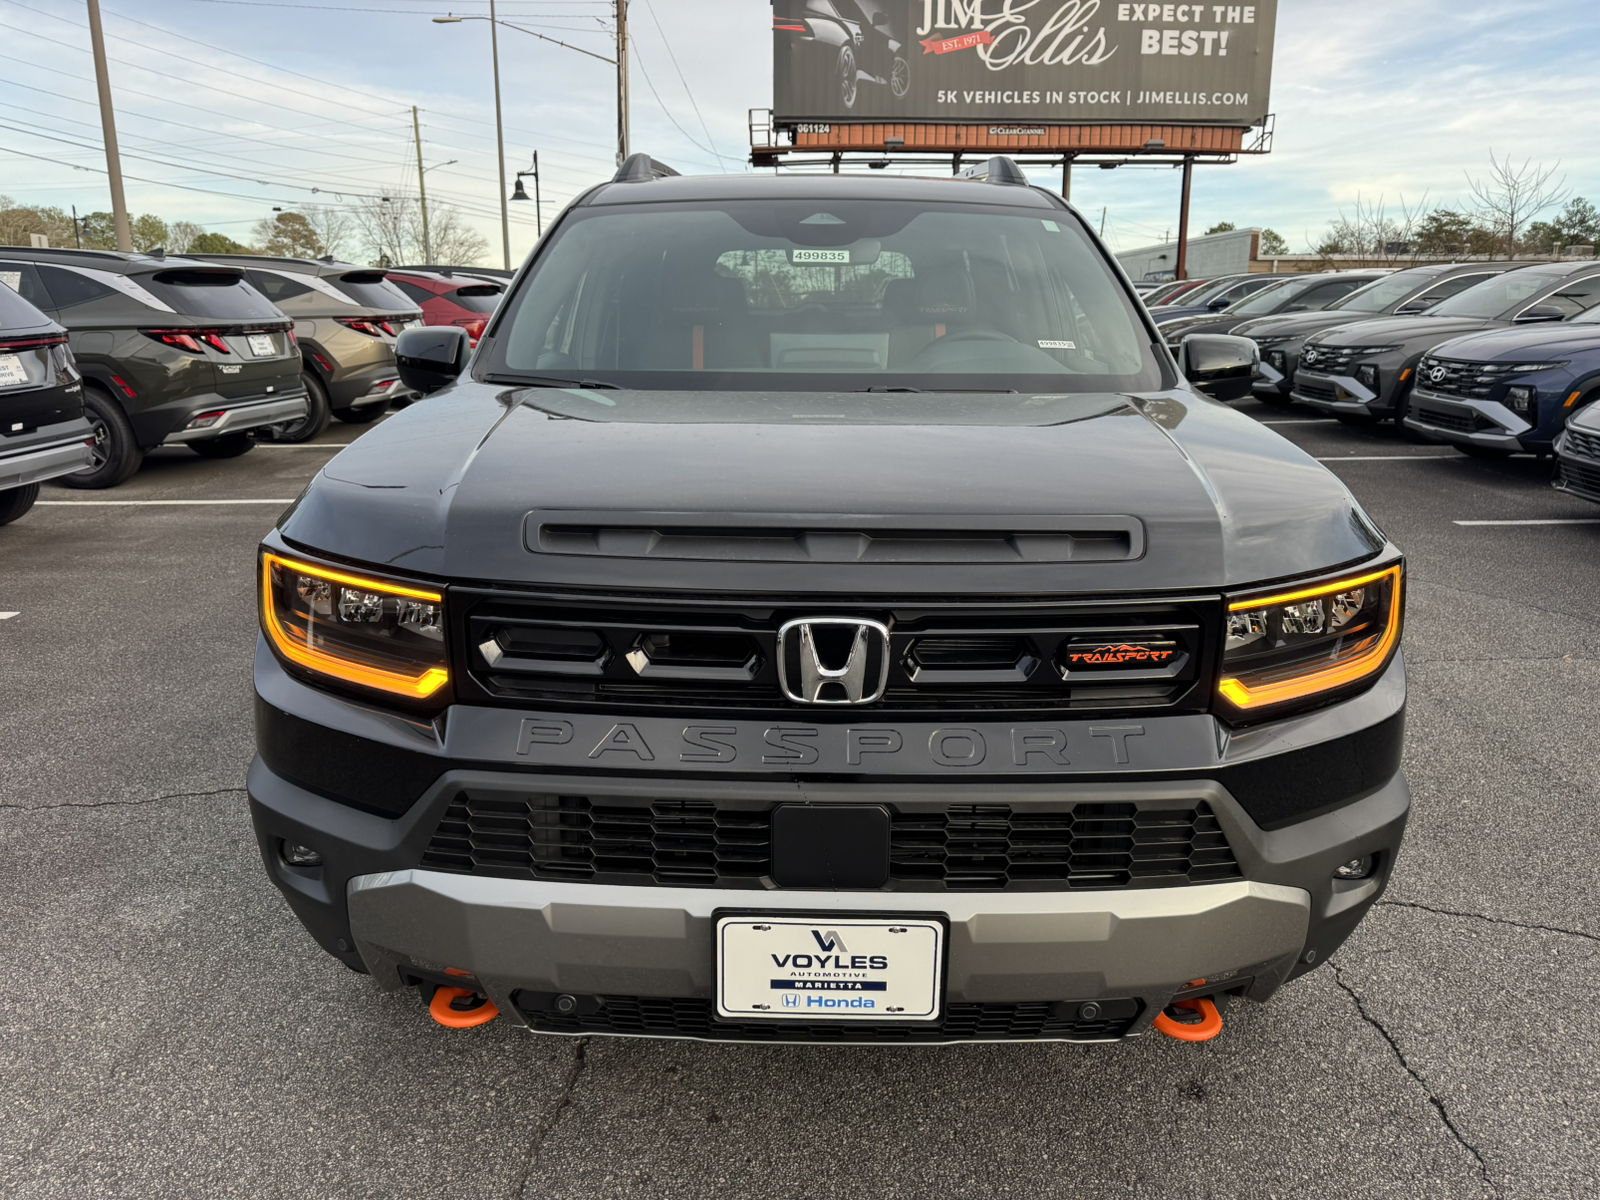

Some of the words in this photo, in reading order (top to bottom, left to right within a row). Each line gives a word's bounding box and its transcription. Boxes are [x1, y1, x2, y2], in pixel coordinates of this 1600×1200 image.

[916, 0, 985, 36] JIM
[1117, 3, 1204, 23] EXPECT
[1212, 5, 1256, 24] THE
[941, 38, 962, 51] EST.
[963, 35, 981, 47] 1971
[963, 0, 1119, 71] Ellis
[1140, 28, 1229, 57] BEST!
[937, 90, 958, 104] 5K
[963, 90, 1041, 104] VEHICLES
[1046, 91, 1064, 104] IN
[1068, 91, 1121, 105] STOCK
[1137, 91, 1249, 106] JIMELLIS.COM
[797, 123, 831, 133] 061124
[795, 251, 845, 261] 499835
[1069, 650, 1173, 664] TRAILSPORT
[515, 717, 1147, 767] PASSPORT
[770, 953, 889, 970] VOYLES
[789, 971, 868, 979] AUTOMOTIVE
[794, 981, 863, 990] MARIETTA
[806, 995, 876, 1009] Honda
